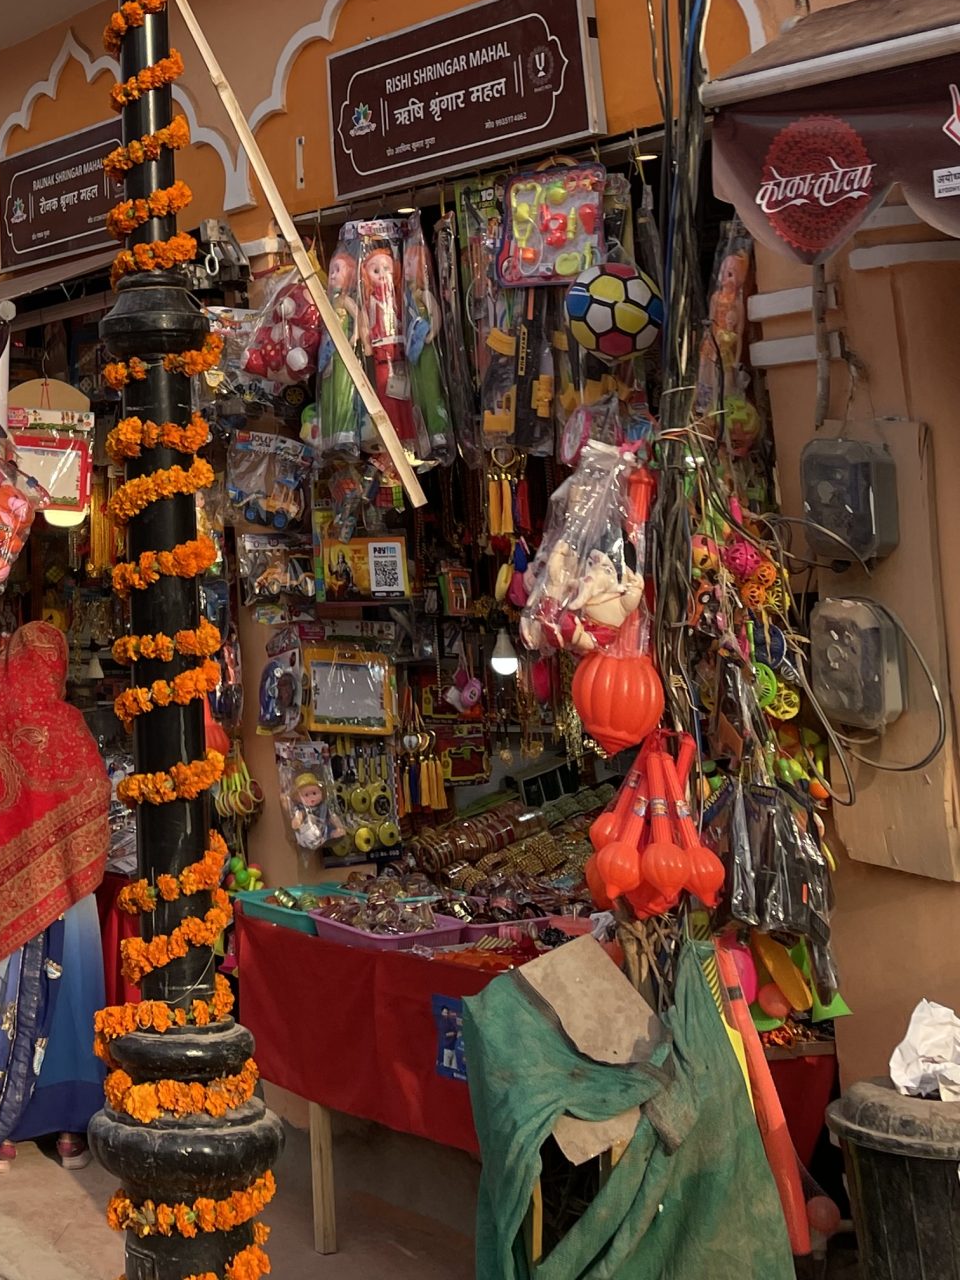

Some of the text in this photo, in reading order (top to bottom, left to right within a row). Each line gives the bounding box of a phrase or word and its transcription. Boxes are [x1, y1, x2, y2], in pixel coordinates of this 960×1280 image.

[385, 41, 511, 94] RISHI SHRINGAR MAHAL
[394, 97, 425, 125] ऋषि
[470, 77, 507, 103] महल
[55, 164, 83, 184] SHRINGAR
[39, 196, 59, 214] रौनक
[79, 184, 99, 201] महल
